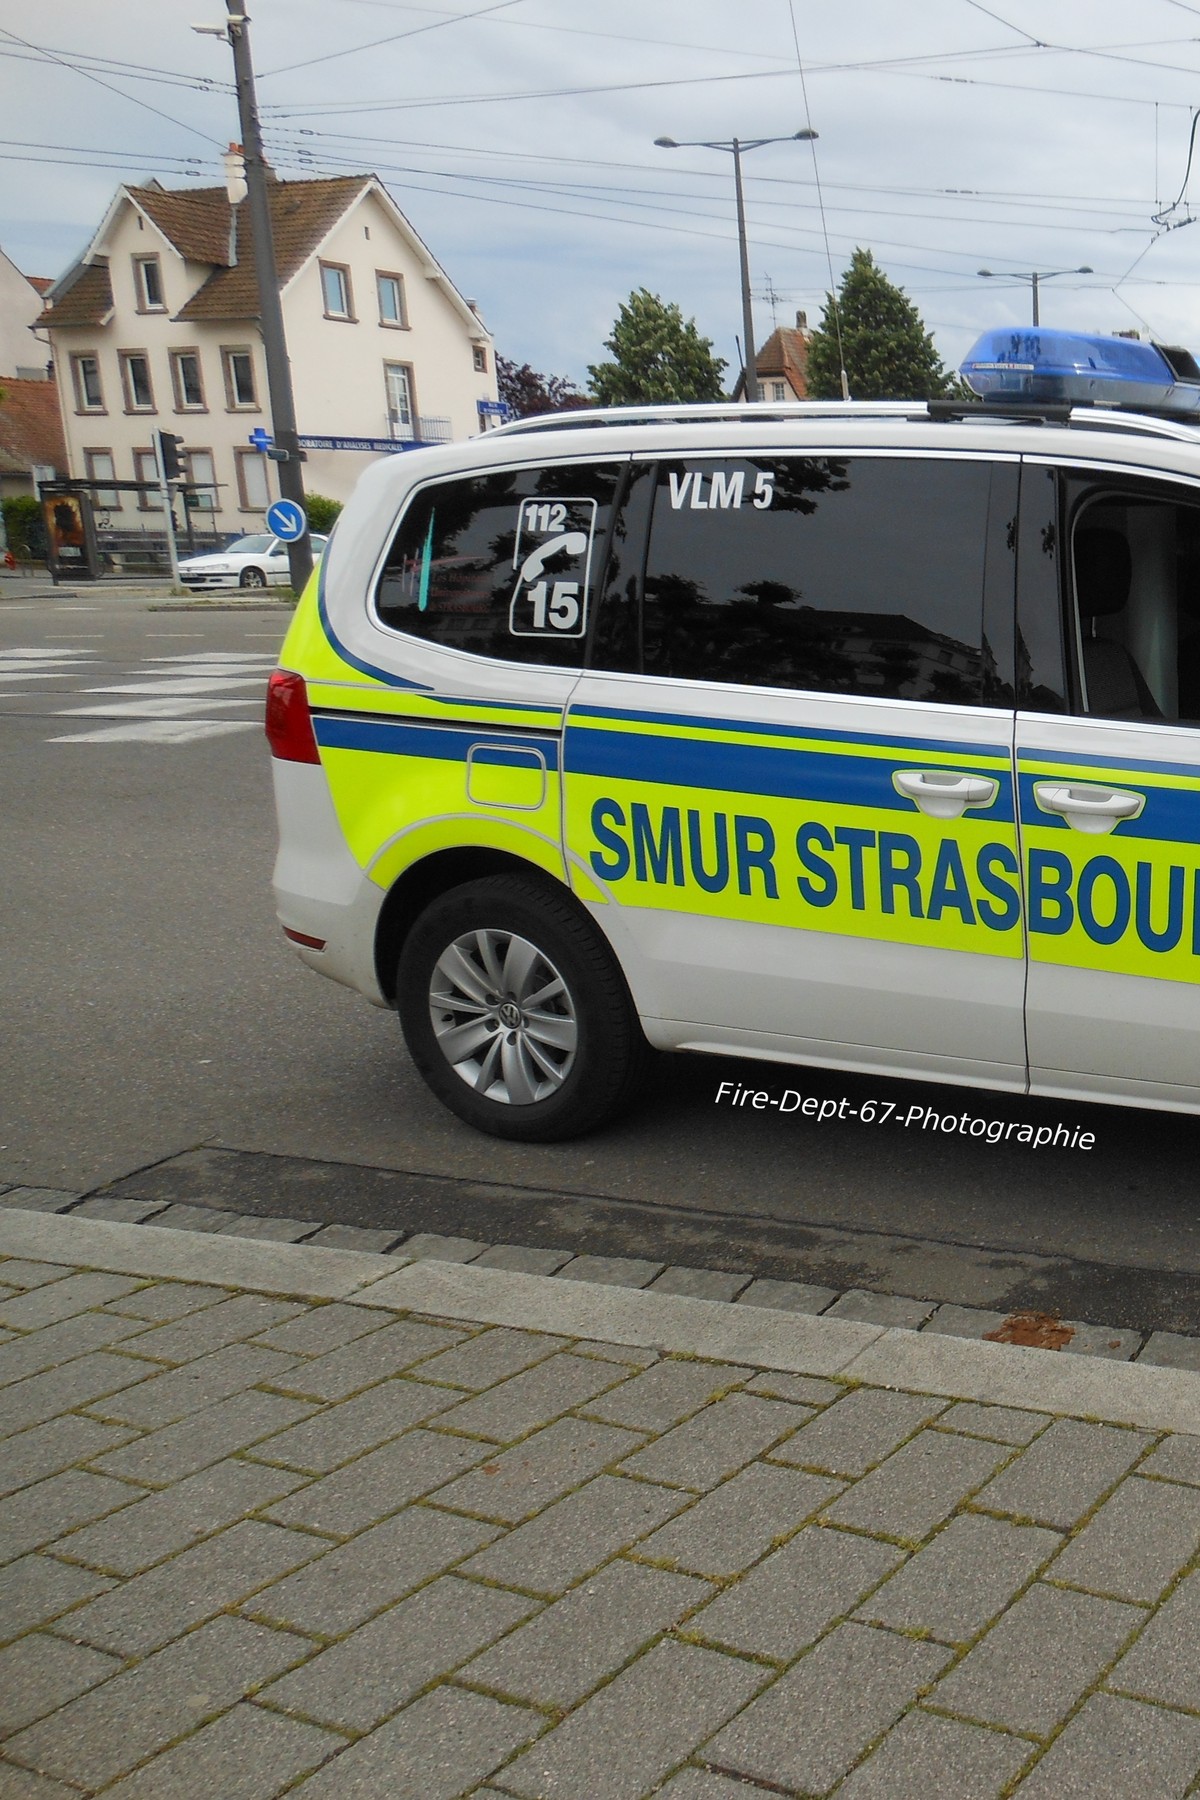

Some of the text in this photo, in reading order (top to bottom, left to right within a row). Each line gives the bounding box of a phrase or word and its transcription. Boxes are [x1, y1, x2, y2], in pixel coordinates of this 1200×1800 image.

[669, 471, 775, 509] VLM 5
[525, 503, 567, 532] 112
[527, 581, 579, 630] 15
[589, 796, 779, 899] SMUR
